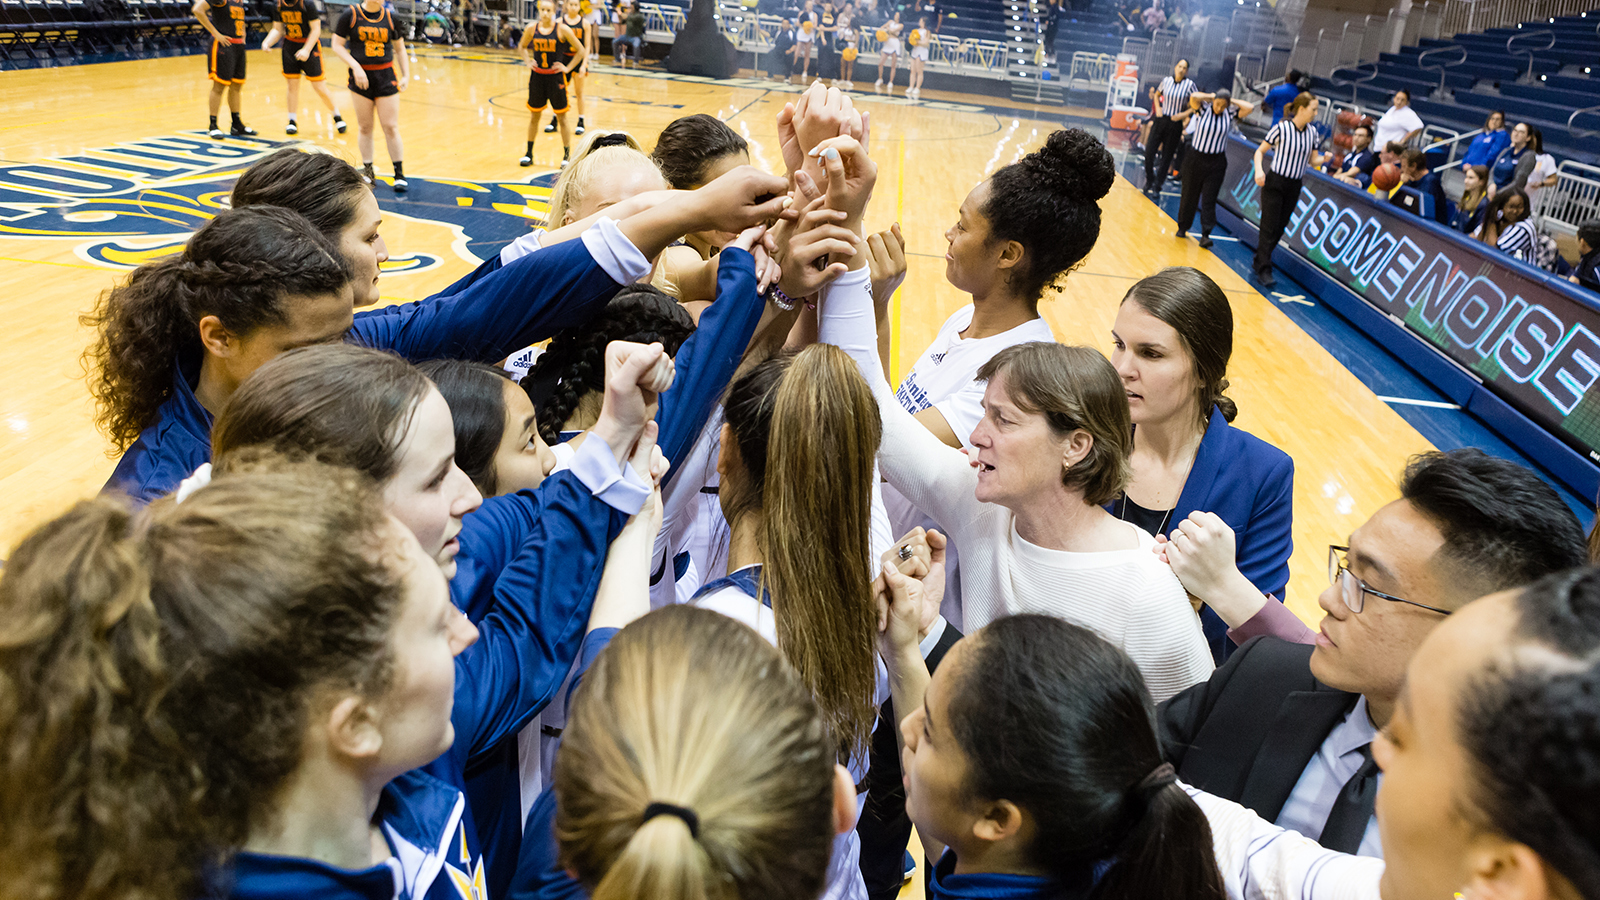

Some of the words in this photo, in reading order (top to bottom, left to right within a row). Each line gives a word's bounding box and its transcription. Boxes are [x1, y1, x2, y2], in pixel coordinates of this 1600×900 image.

[358, 26, 388, 43] STAN
[533, 38, 557, 52] STAN
[541, 52, 549, 68] 1
[1230, 159, 1316, 238] ME
[1300, 198, 1425, 302] SOME
[1405, 252, 1600, 416] NOISE
